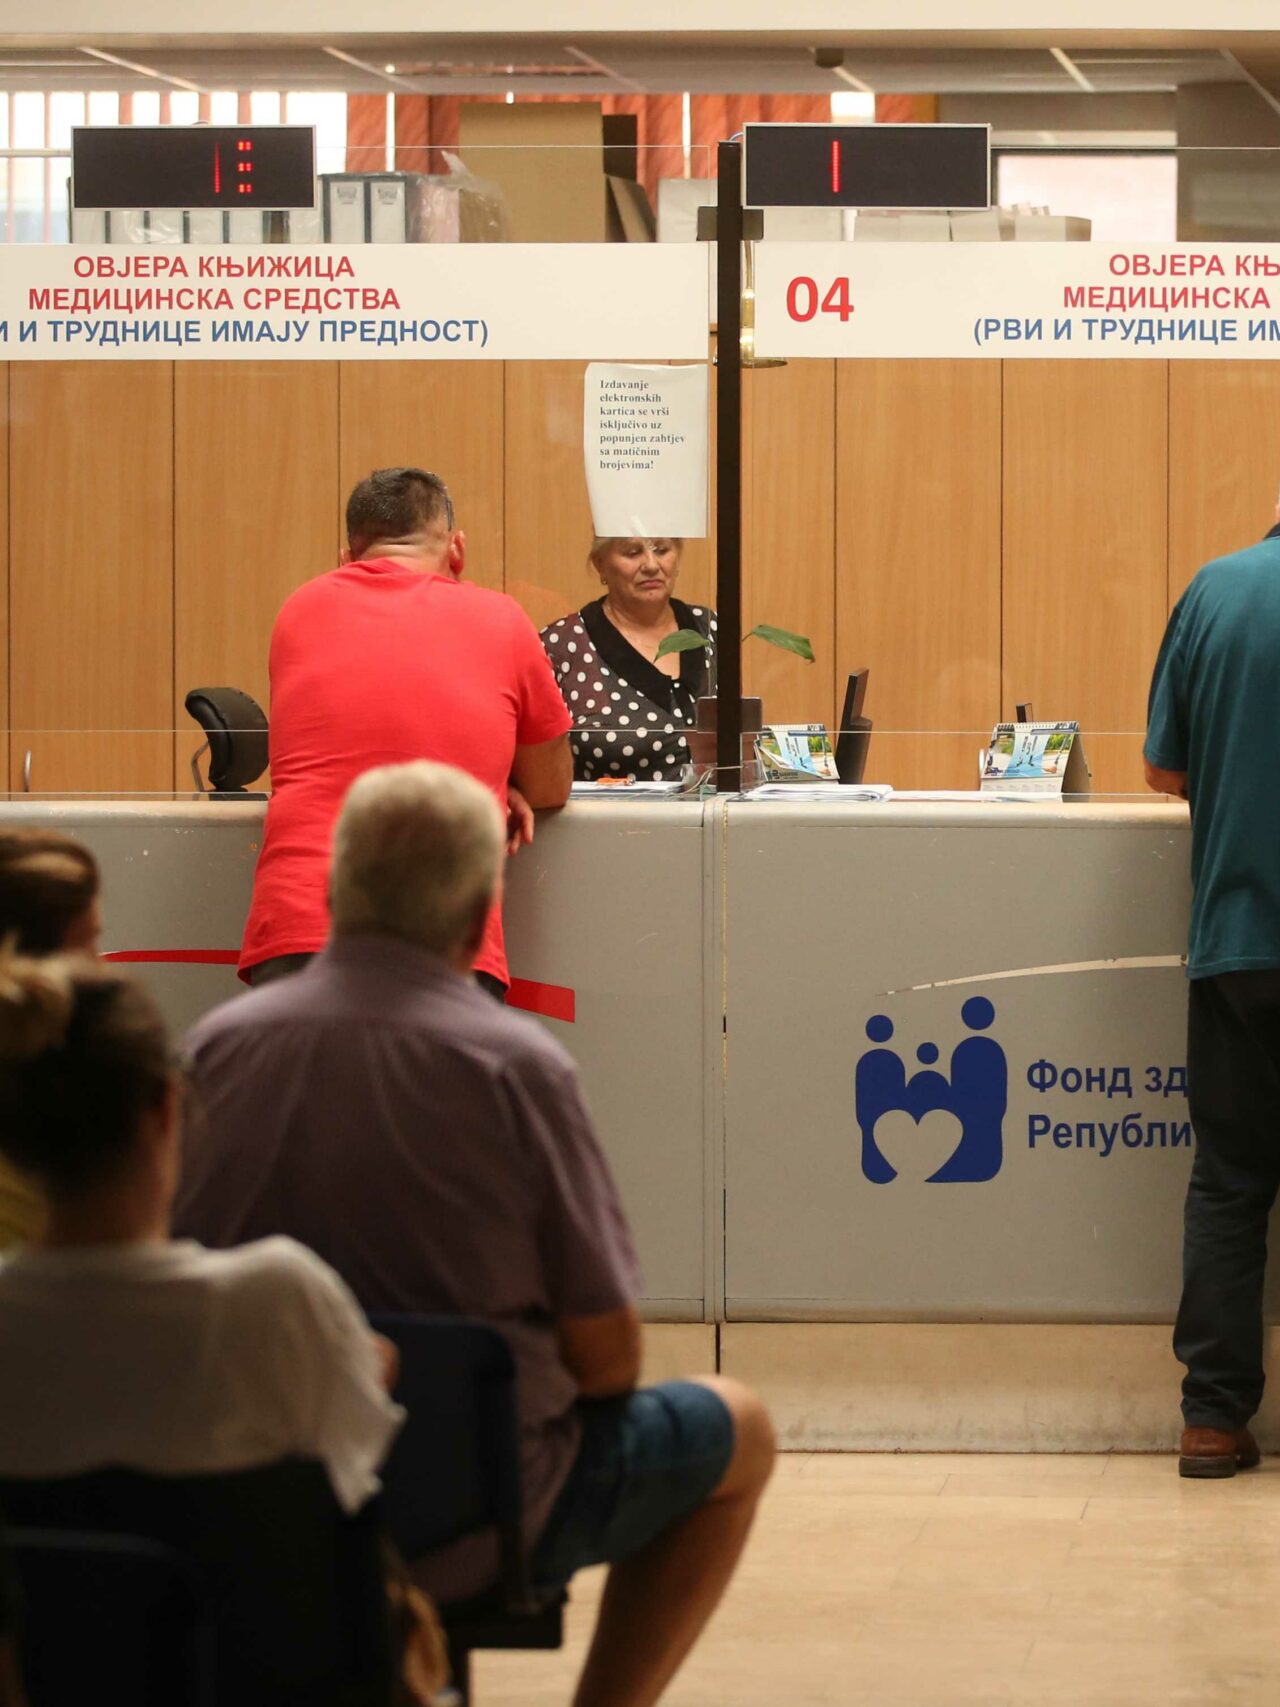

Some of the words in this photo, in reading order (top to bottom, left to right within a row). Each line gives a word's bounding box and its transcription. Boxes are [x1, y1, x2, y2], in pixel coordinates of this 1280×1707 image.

[74, 256, 188, 278] ОВЈЕРА
[199, 256, 355, 282] КЊИЖИЦА
[1109, 254, 1225, 276] ОВЈЕРА
[29, 288, 234, 314] МЕДИЦИНСКА
[244, 288, 400, 314] СРЕДСТВА
[786, 276, 854, 322] 04
[1064, 287, 1270, 312] МЕДИЦИНСКА
[20, 321, 36, 342] И
[47, 321, 200, 346] ТРУДНИЦЕ
[212, 321, 309, 342] ИМАЈУ
[320, 320, 488, 347] ПРЕДНОСТ)
[975, 319, 1042, 347] (РВИ
[1054, 319, 1071, 340] И
[1082, 319, 1237, 345] ТРУДНИЦЕ
[600, 380, 649, 391] Izdavanje
[600, 393, 661, 402] elektronskih
[600, 407, 635, 415] kartica
[651, 407, 670, 416] vrši
[600, 420, 648, 431] isključivo
[600, 434, 647, 444] popunjen
[649, 434, 685, 445] zahtjev
[613, 447, 660, 456] matičnim
[600, 460, 654, 471] brojevima!
[1027, 1059, 1133, 1099] Фонд
[1028, 1112, 1192, 1158] Републи
